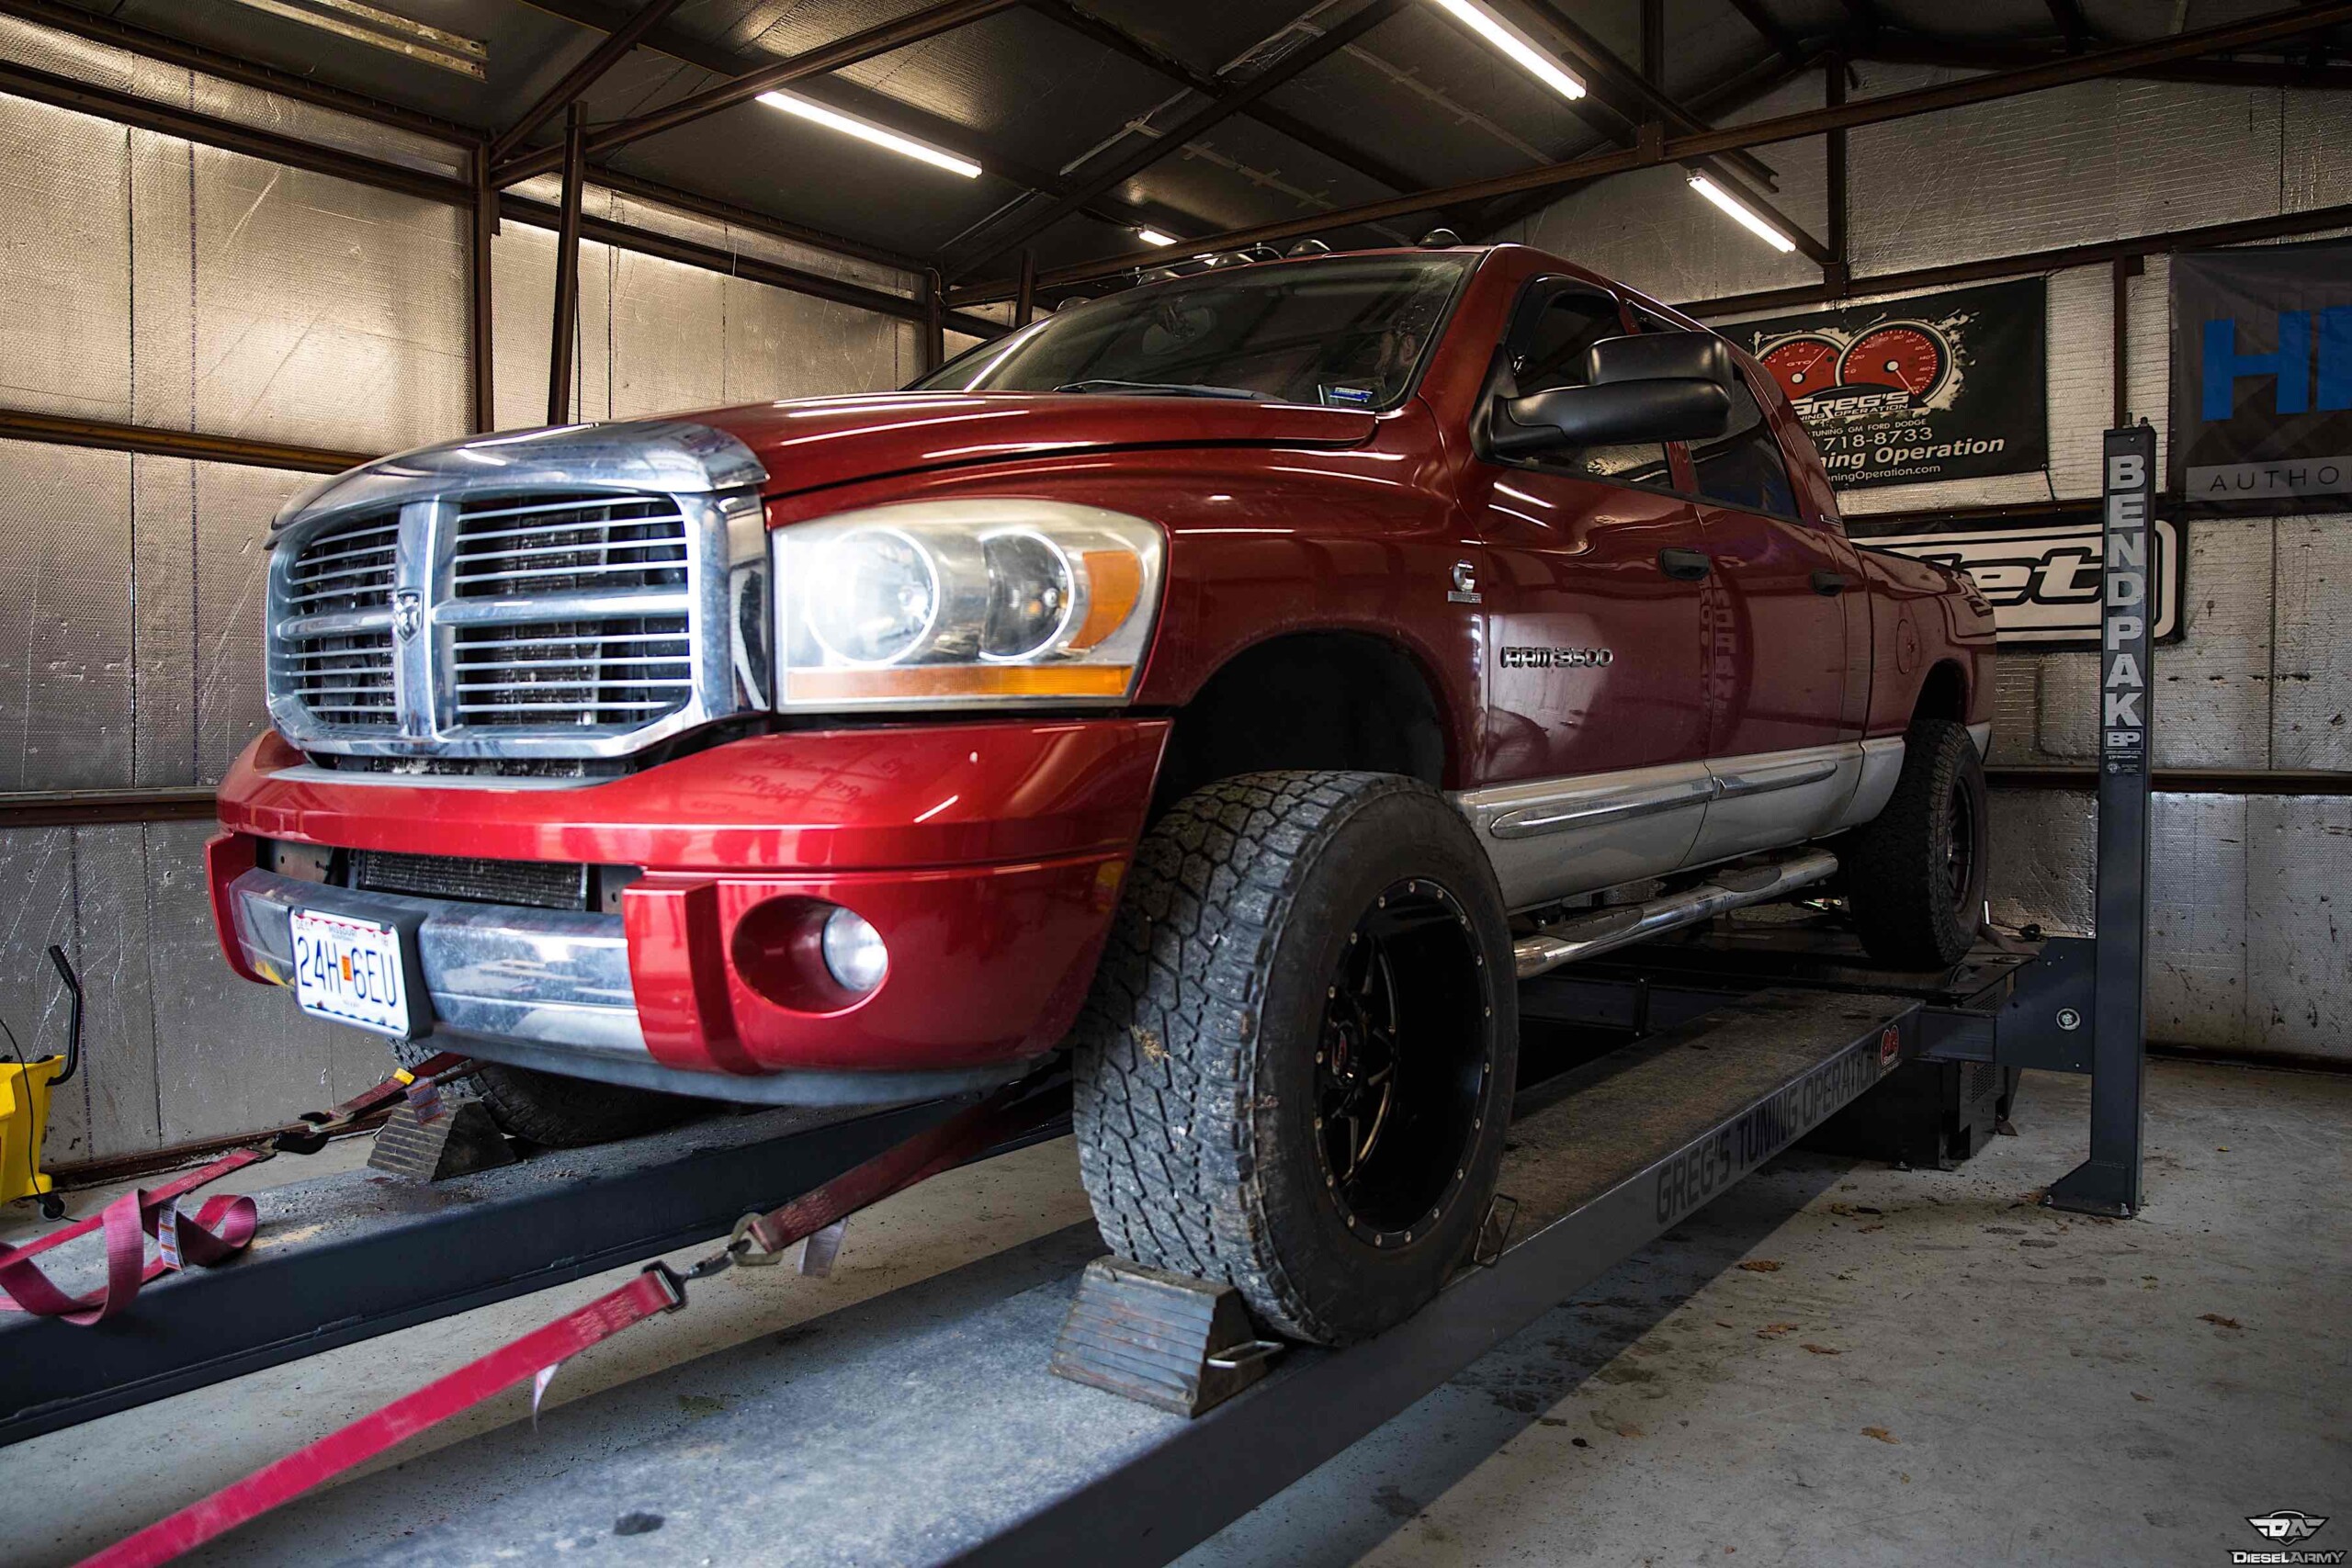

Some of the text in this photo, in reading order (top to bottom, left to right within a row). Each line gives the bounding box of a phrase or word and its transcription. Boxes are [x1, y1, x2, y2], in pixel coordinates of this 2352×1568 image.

[1835, 403, 1908, 417] OPERATION
[1812, 427, 1843, 437] TUNING
[1868, 422, 1891, 431] FORD
[1895, 418, 1927, 428] DODGE
[1824, 427, 1933, 451] 718-8733
[1874, 437, 2005, 466] Operation
[2209, 465, 2352, 491] AUTHO
[2105, 454, 2146, 728] BENDPAK
[1500, 647, 1614, 668] RAM 3500
[2107, 731, 2141, 747] BP
[298, 936, 397, 1008] 24H 6EU
[1657, 1131, 1730, 1224] GREG'S
[1736, 1086, 1797, 1170] TUNING
